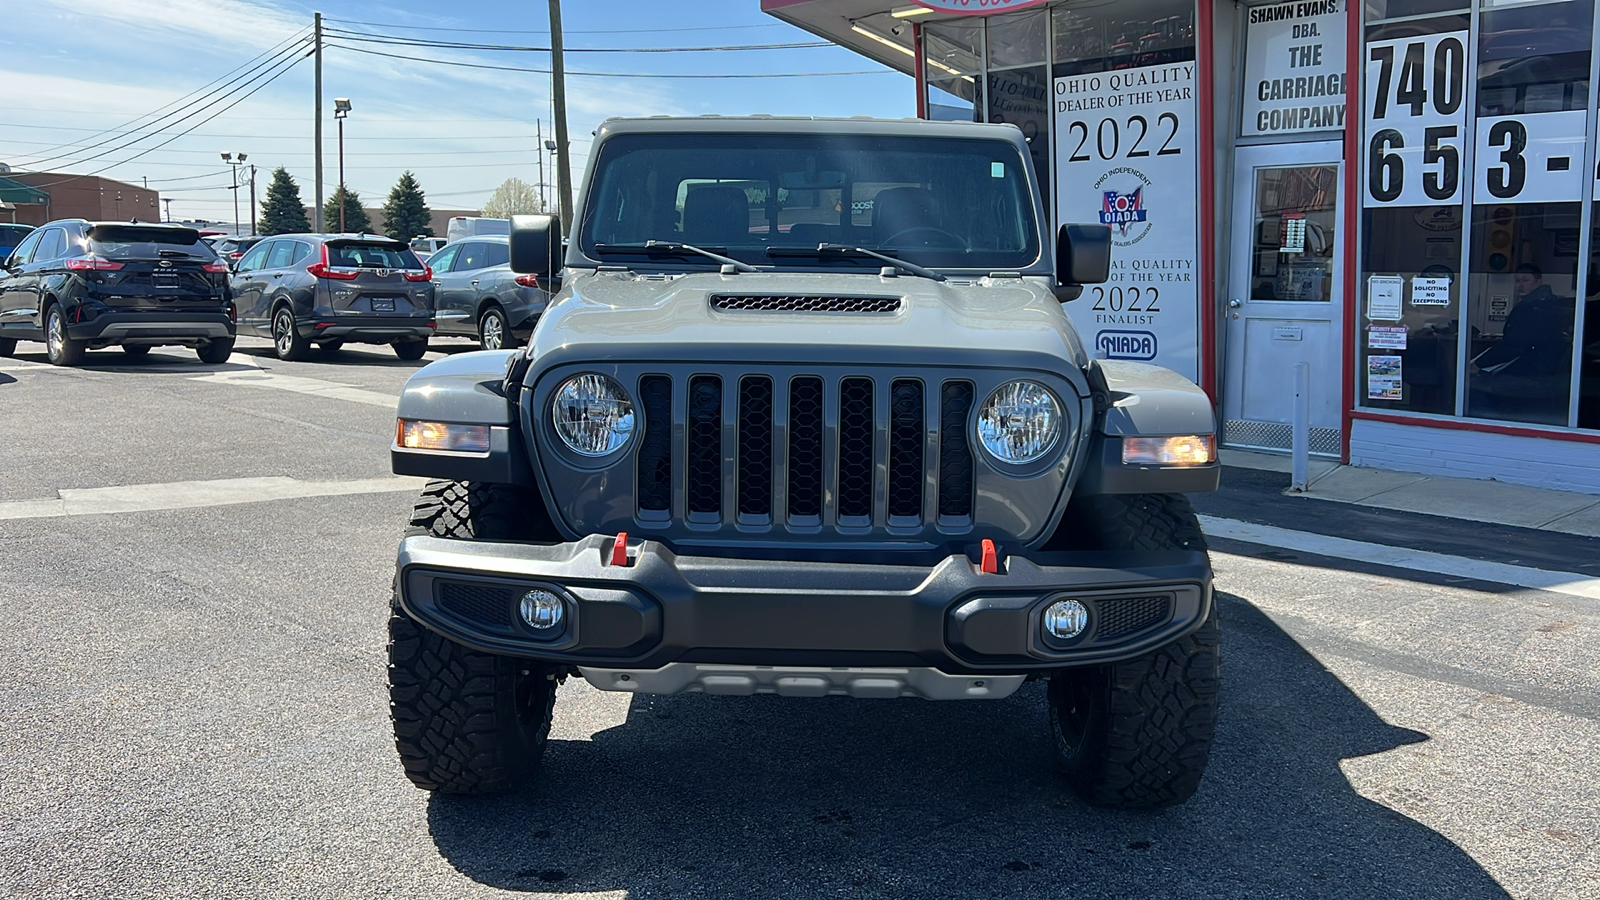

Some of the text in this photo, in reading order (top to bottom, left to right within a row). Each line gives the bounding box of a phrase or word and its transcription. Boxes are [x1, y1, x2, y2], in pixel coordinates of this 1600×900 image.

[1250, 5, 1294, 24] SHAWN
[1292, 23, 1321, 39] DBA.
[1288, 44, 1323, 68] THE
[1056, 65, 1194, 95] OHIO QUALITY
[1369, 36, 1465, 120] 740
[1058, 97, 1105, 113] DEALER
[1107, 94, 1125, 108] OF
[1127, 91, 1153, 106] THE
[1156, 87, 1192, 102] YEAR
[1257, 104, 1347, 132] COMPANY
[1068, 112, 1182, 163] 2022
[1094, 166, 1152, 190] OHIO INDEPENDENT
[1104, 210, 1139, 223] OIADA
[1131, 222, 1153, 246] ASSOCIATION
[1132, 259, 1193, 270] QUALITY
[1111, 273, 1191, 282] OF THE YEAR
[1091, 286, 1160, 313] 2022
[1096, 315, 1155, 324] FINALIST
[1100, 336, 1152, 355] NIADA
